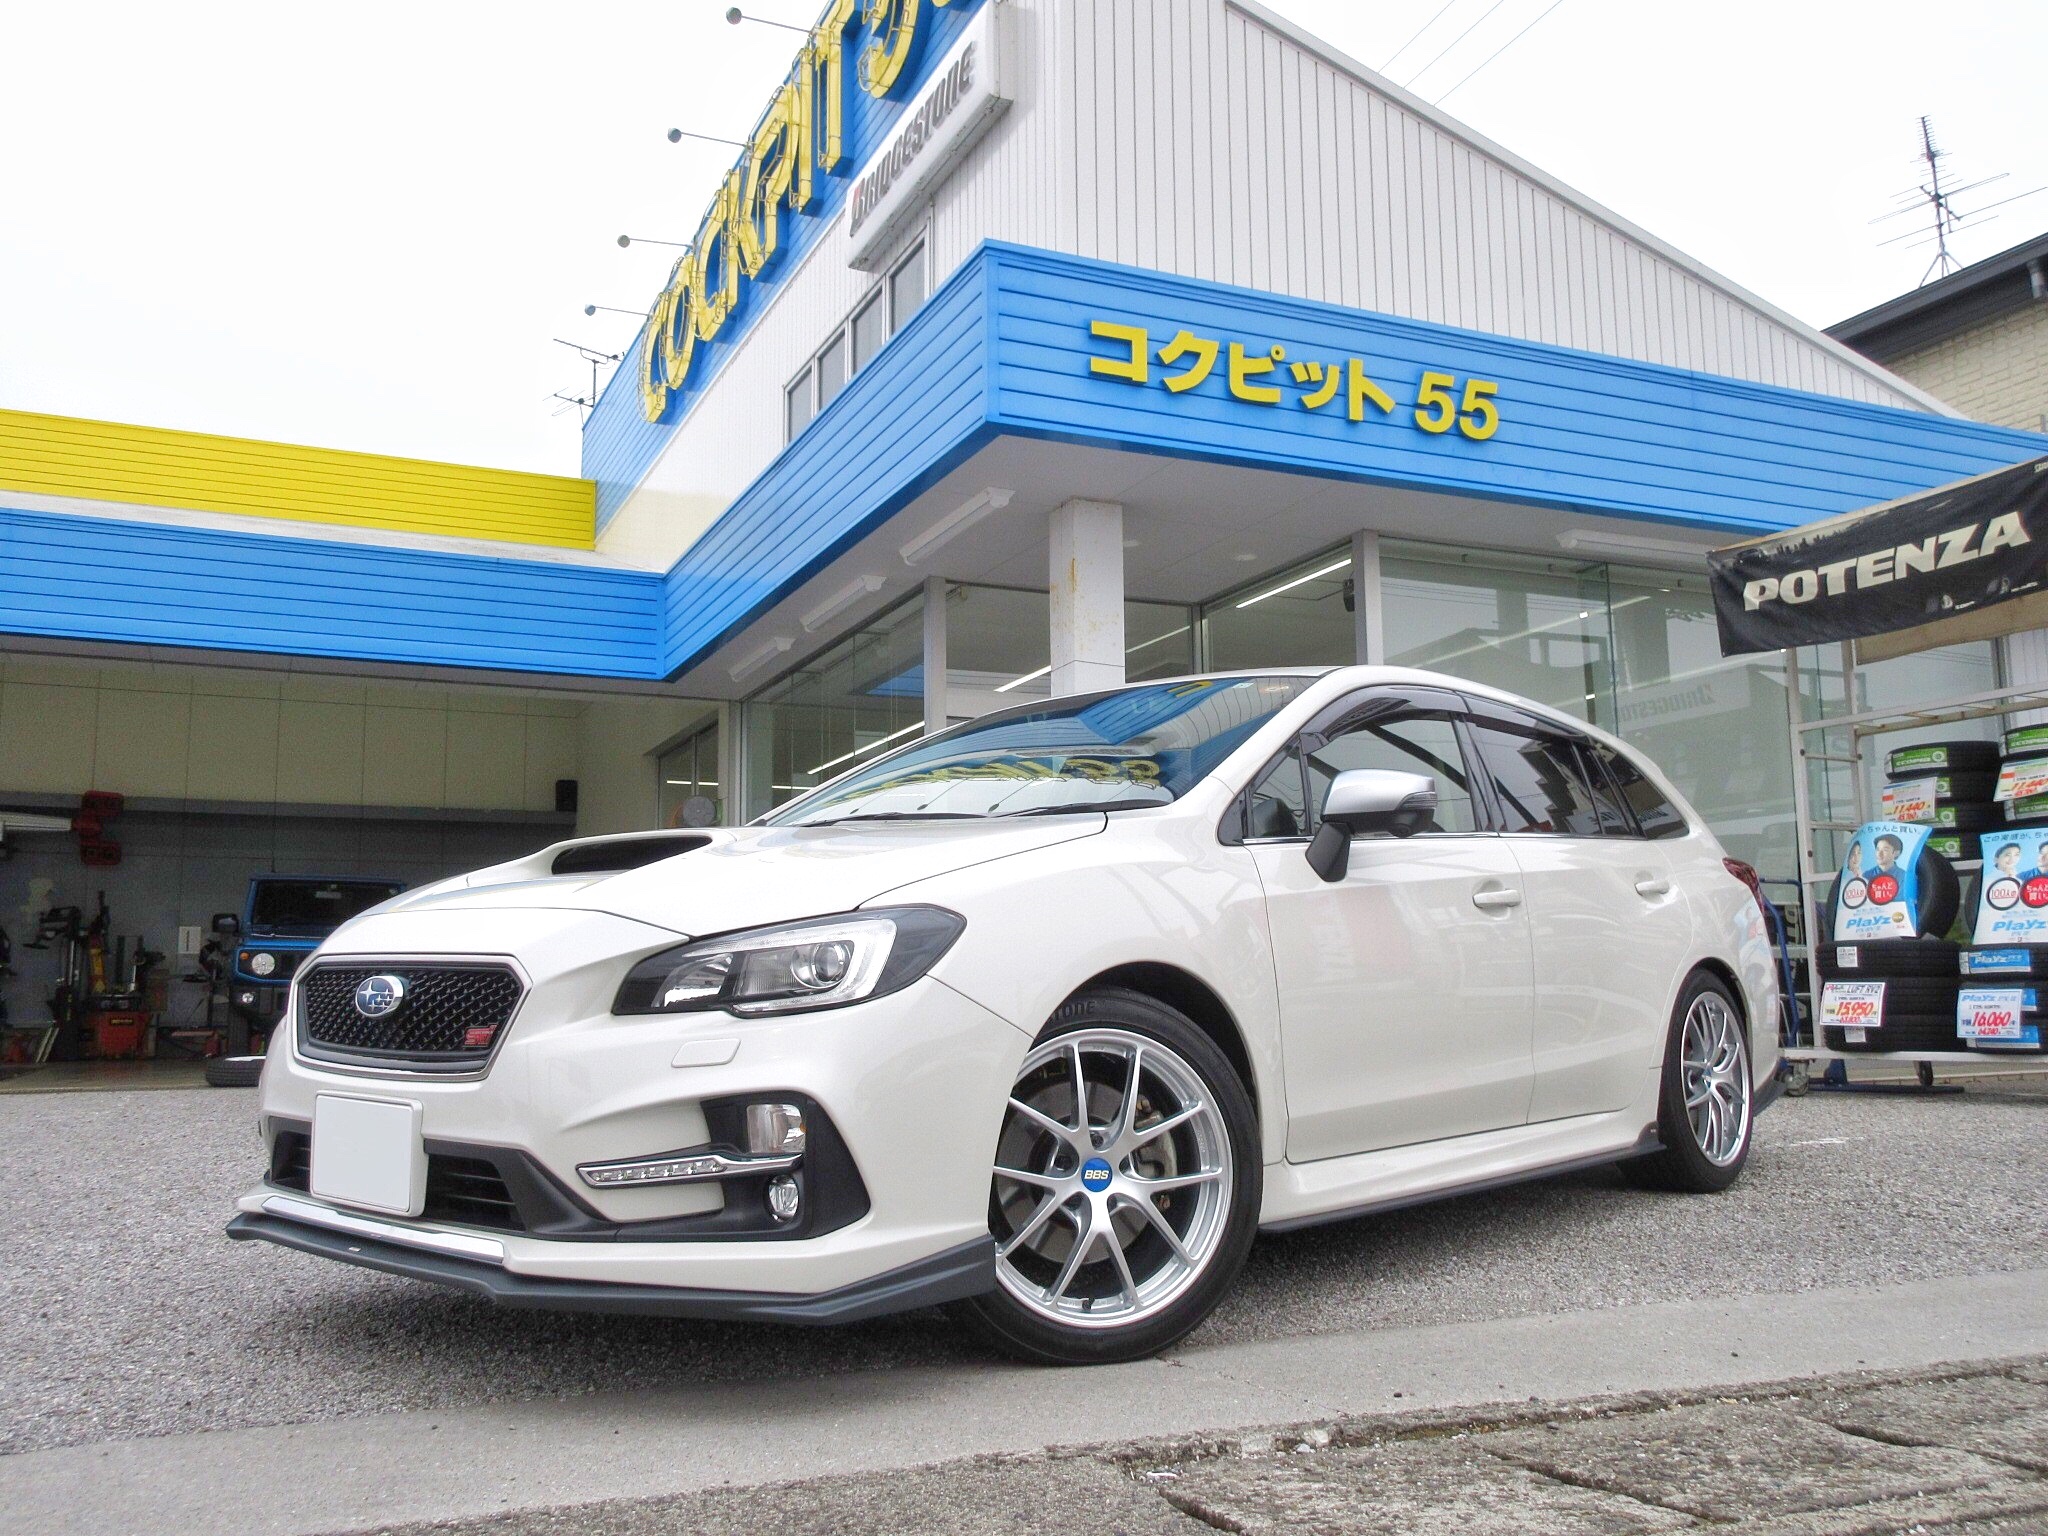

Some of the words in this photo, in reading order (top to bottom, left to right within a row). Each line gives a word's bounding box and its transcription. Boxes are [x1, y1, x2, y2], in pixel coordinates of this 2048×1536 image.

[1090, 319, 1396, 421] コクピット
[1414, 371, 1499, 441] 55
[1743, 511, 2032, 611] POTENZA
[1084, 1169, 1110, 1181] BBS
